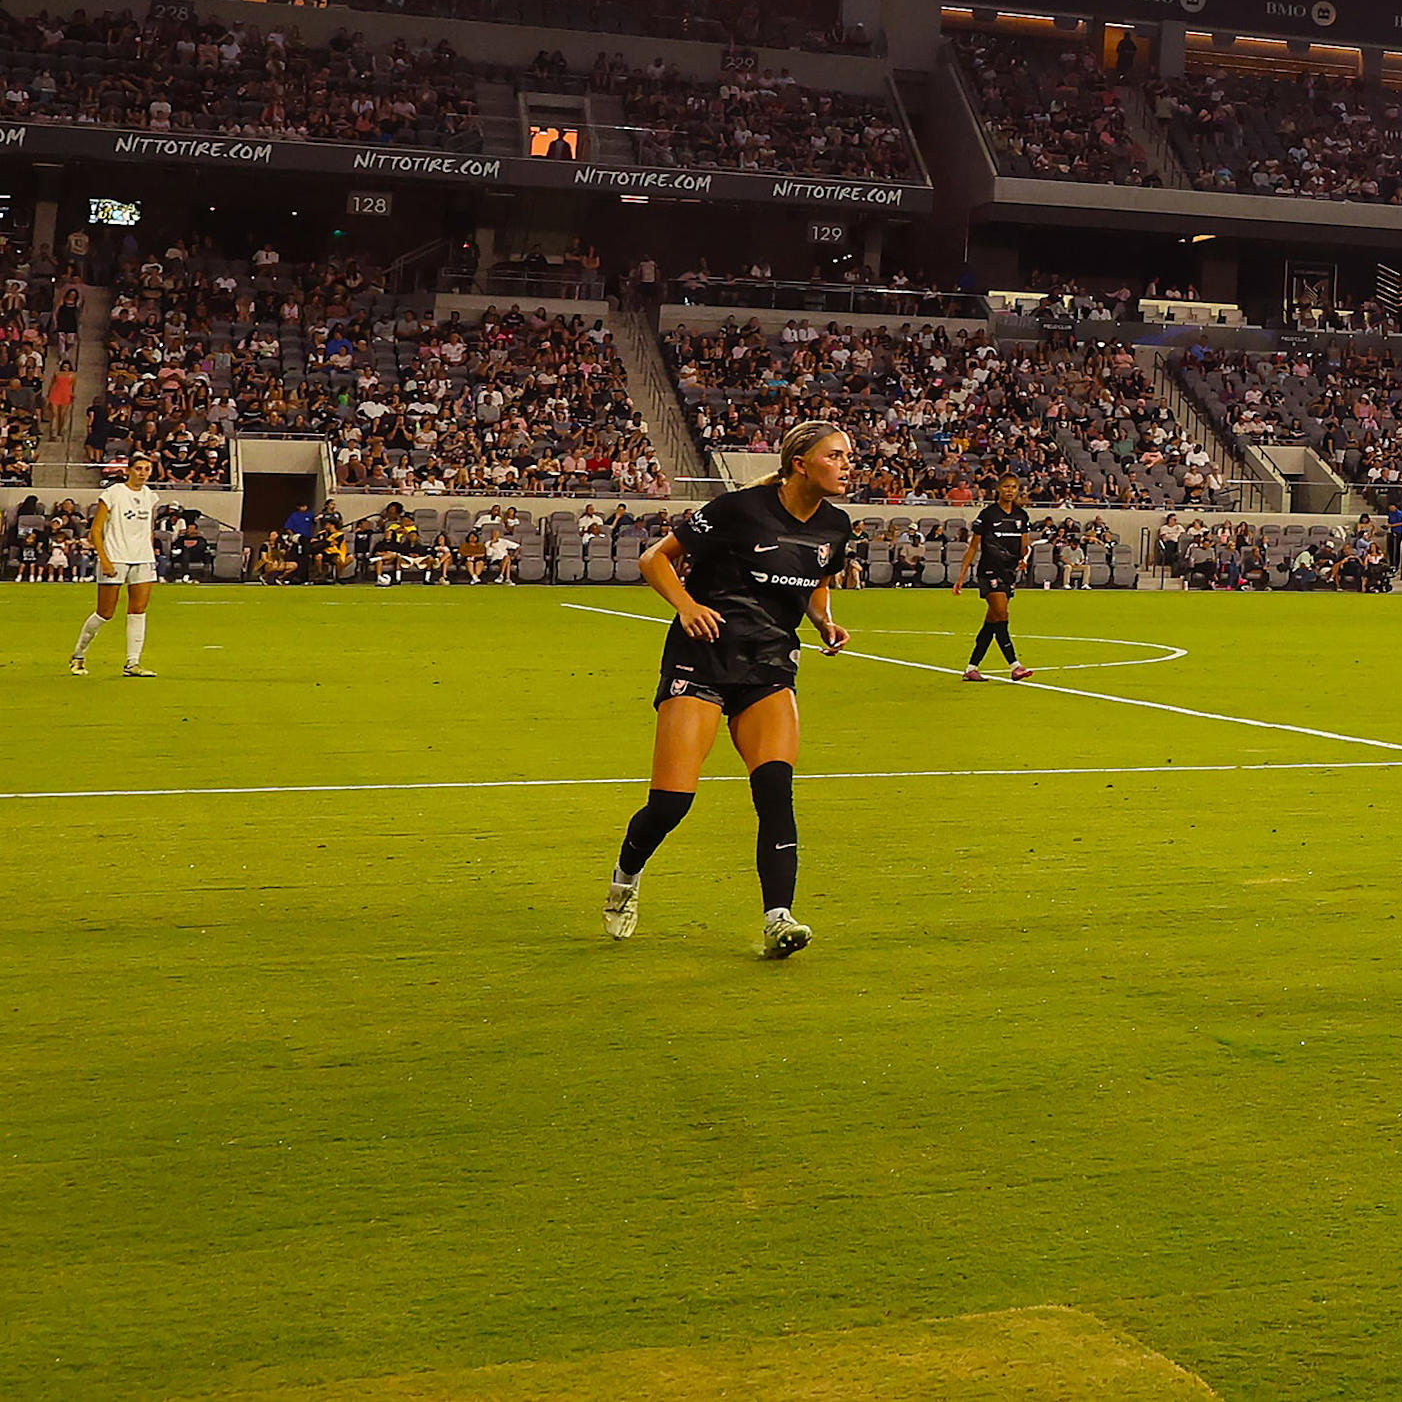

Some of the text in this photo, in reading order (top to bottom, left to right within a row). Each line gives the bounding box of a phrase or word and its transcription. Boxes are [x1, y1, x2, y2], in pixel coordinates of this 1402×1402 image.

[1266, 2, 1307, 19] BMO
[115, 133, 272, 164] NITTOTIRE.COM
[353, 149, 500, 179] NITTOTIRE.COM
[574, 166, 712, 194] NITTOTIRE.COM
[772, 180, 903, 206] NITTOTIRE.COM
[352, 197, 387, 213] 128
[812, 226, 842, 241] 129
